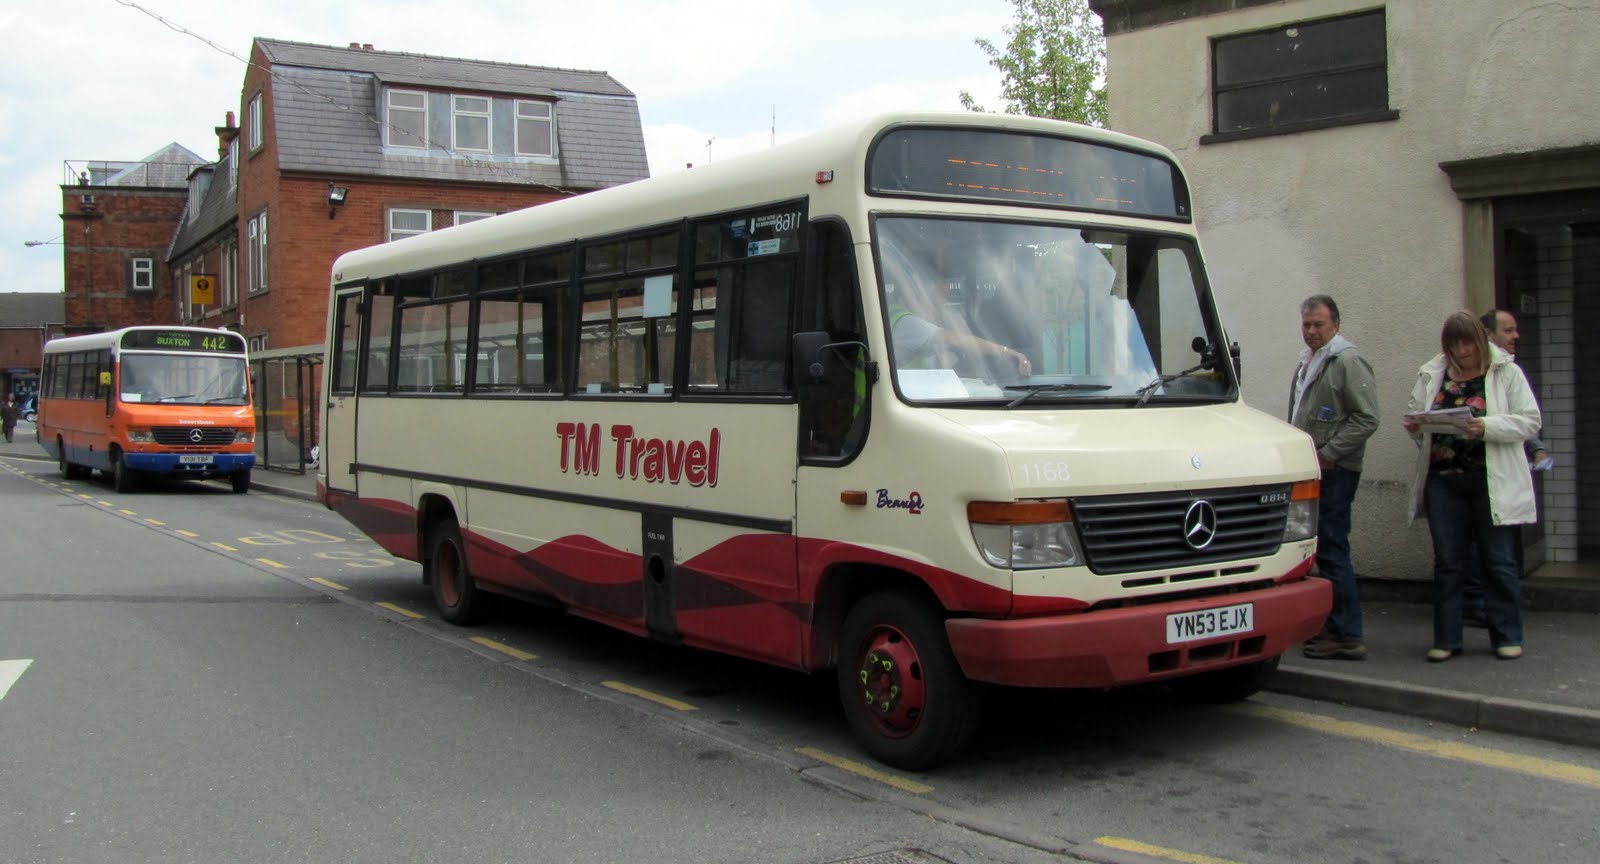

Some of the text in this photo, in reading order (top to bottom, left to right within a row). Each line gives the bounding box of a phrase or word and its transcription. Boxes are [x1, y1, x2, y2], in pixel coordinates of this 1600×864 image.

[157, 336, 226, 350] BUXTON 442
[556, 422, 721, 488] TM Travel
[1020, 461, 1072, 482] 1168
[1269, 493, 1287, 503] 814
[1174, 607, 1248, 638] YN53 EJX
